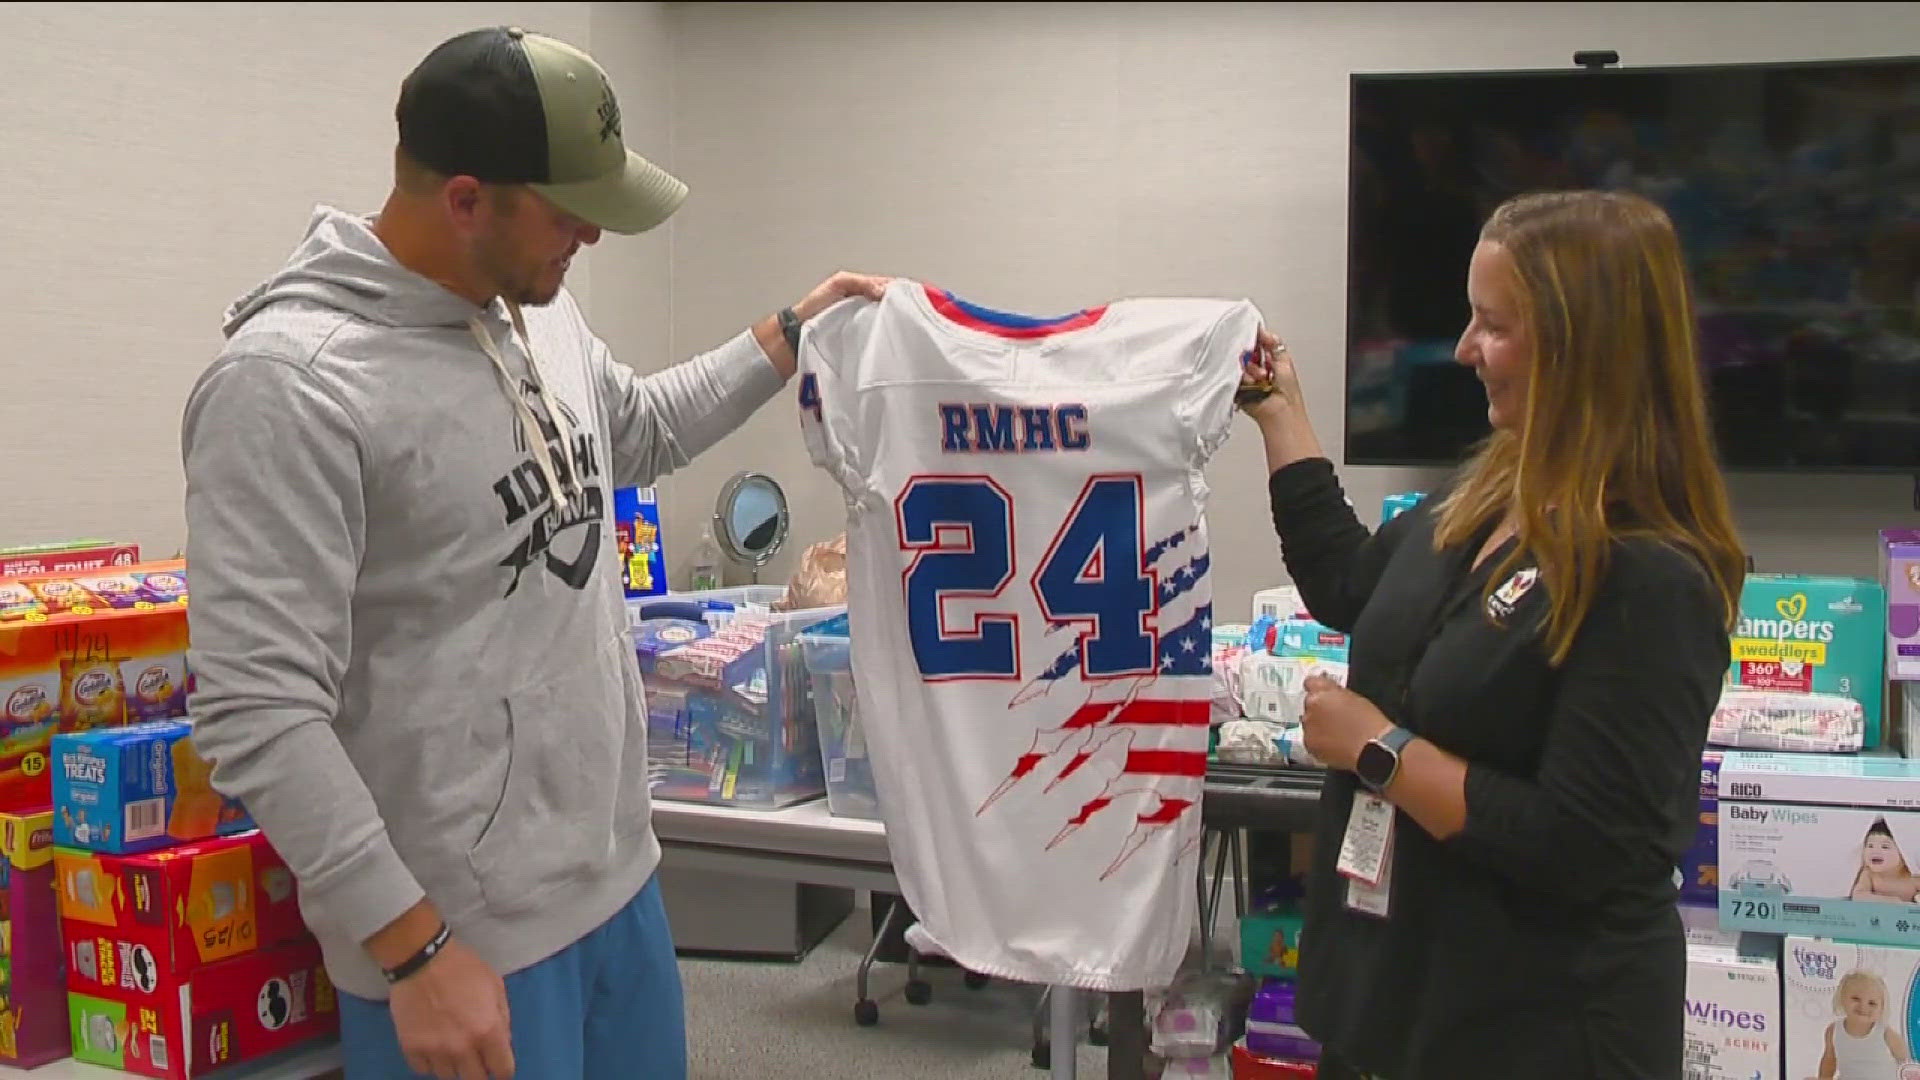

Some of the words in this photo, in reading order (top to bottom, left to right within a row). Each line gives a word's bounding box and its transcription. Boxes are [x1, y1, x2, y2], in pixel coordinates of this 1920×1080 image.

[938, 403, 1091, 453] RMHC
[895, 474, 1158, 682] 24
[1737, 618, 1834, 643] ampers
[1740, 645, 1818, 658] swaddlers
[1839, 678, 1850, 693] 3
[24, 757, 43, 771] 15
[65, 764, 106, 784] TREATS
[1731, 782, 1762, 797] RICO
[1731, 806, 1768, 824] Baby
[1772, 809, 1819, 825] Wipes
[1731, 901, 1770, 920] 720
